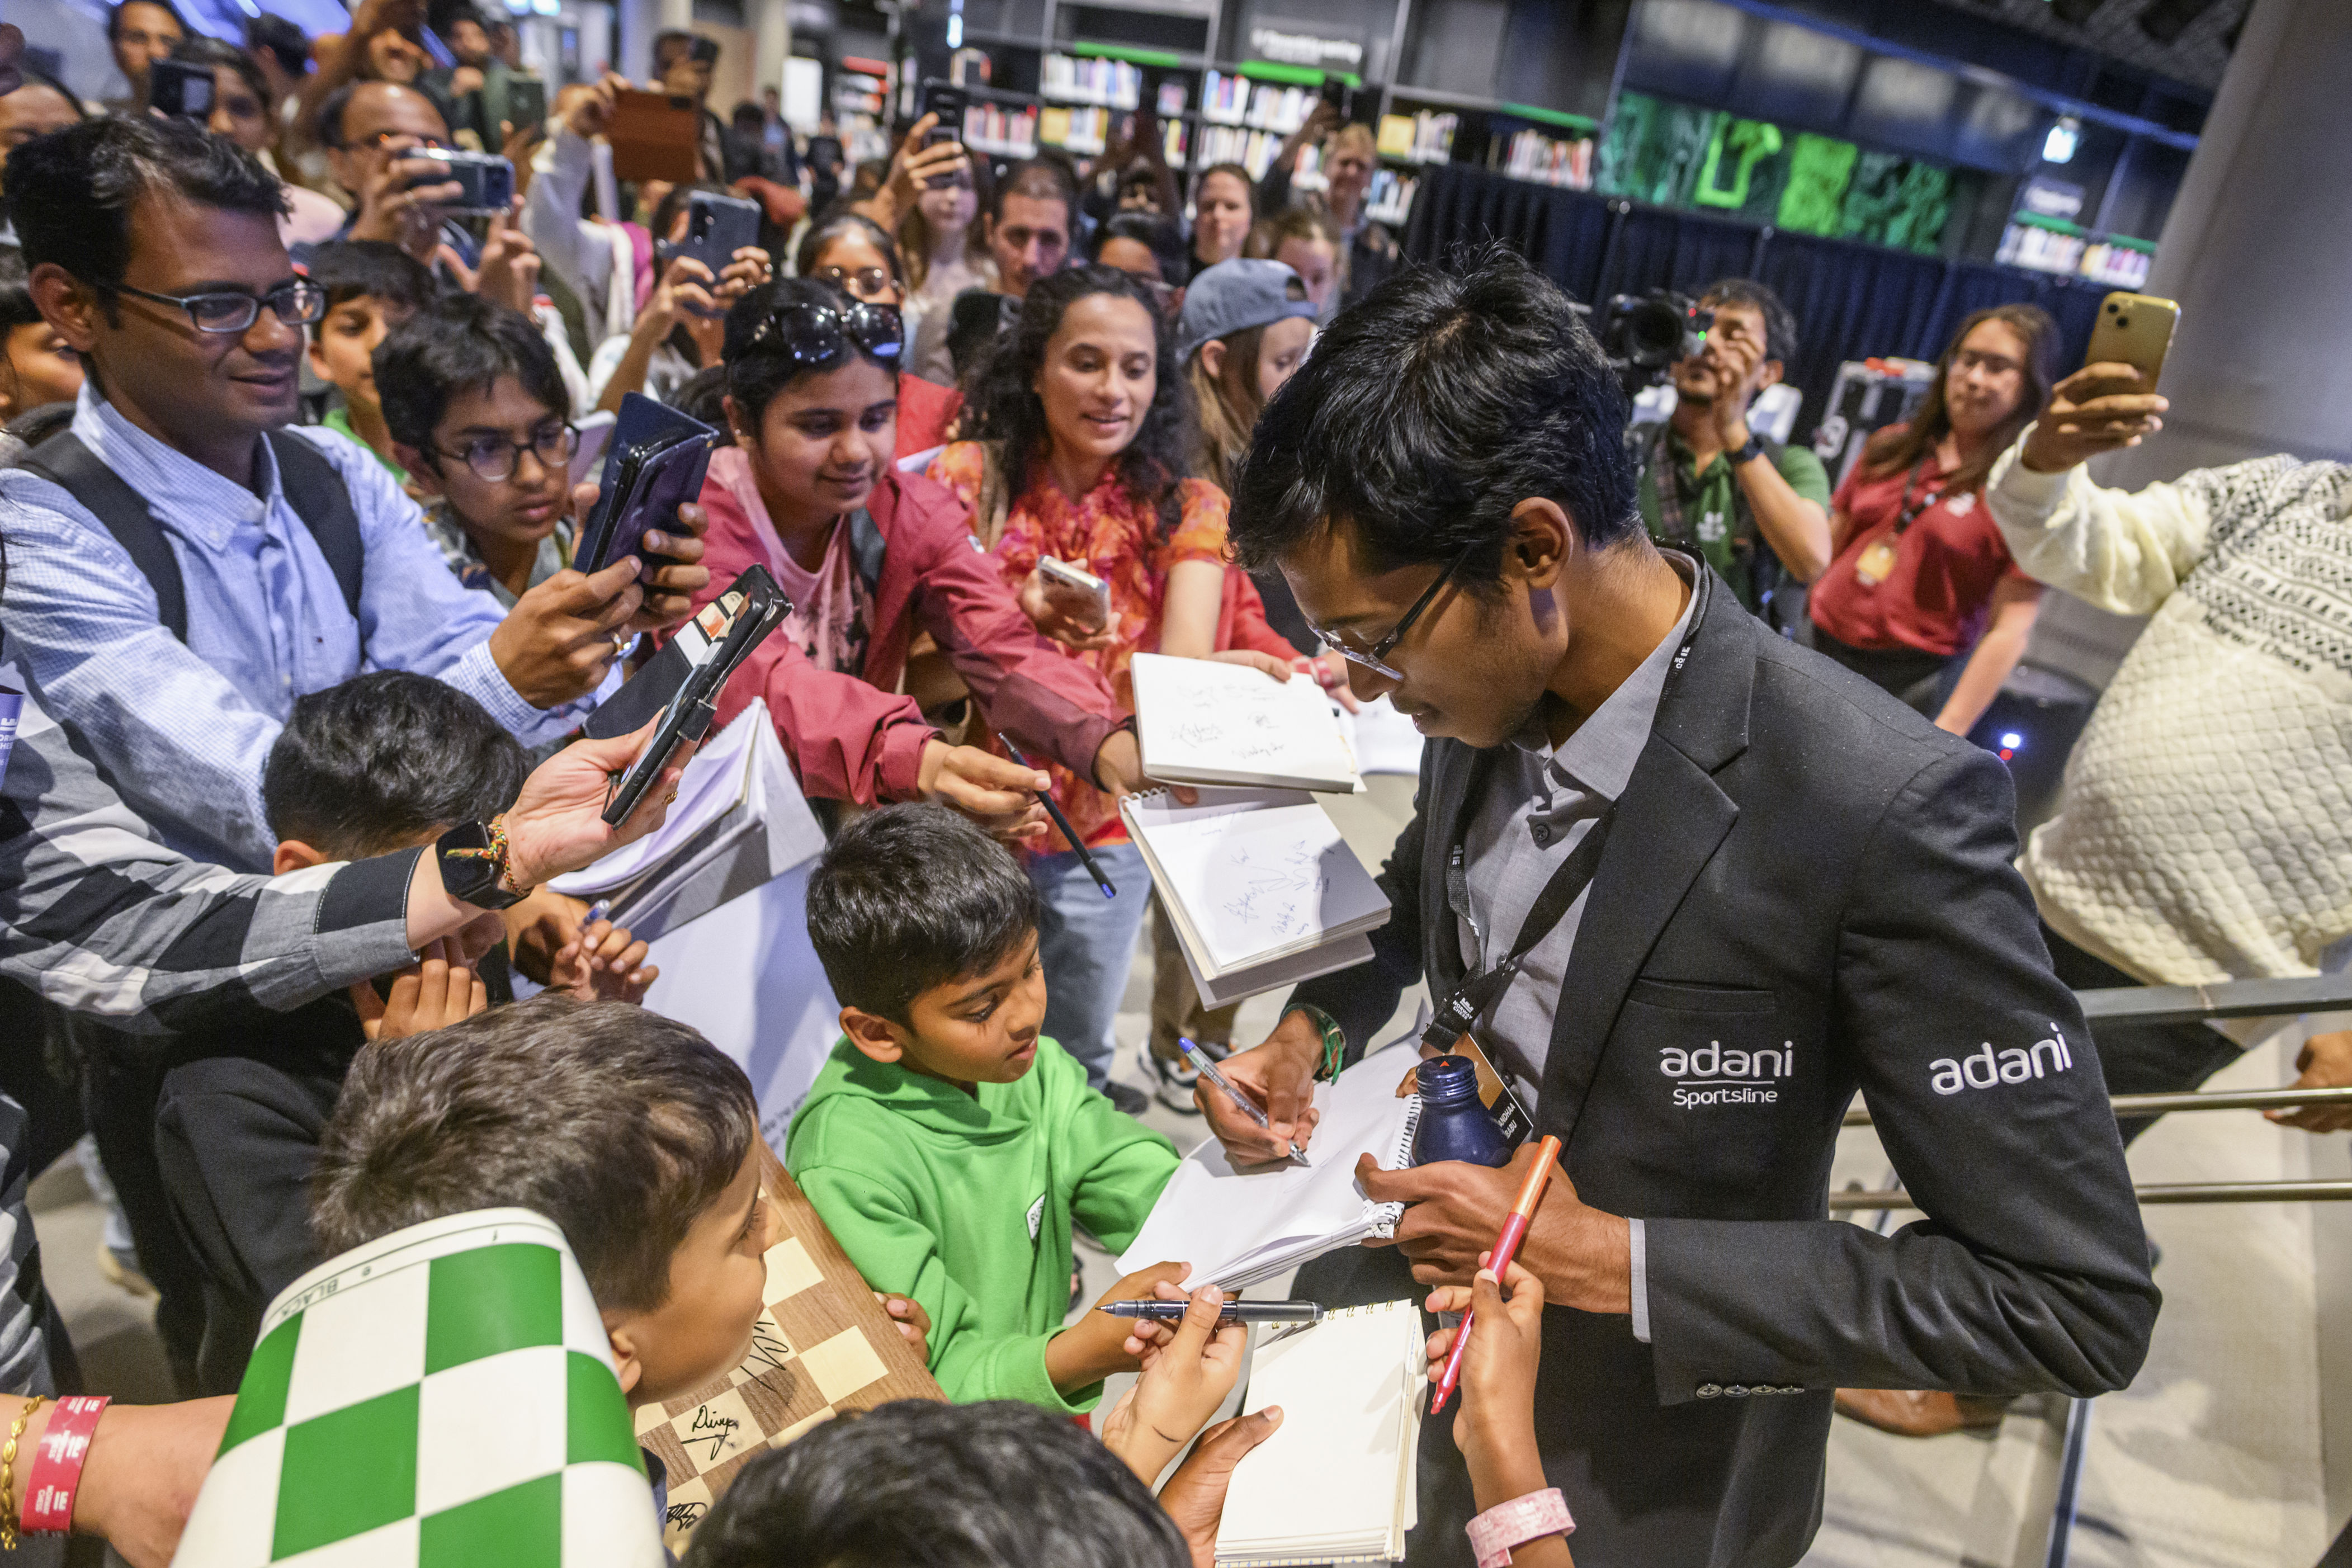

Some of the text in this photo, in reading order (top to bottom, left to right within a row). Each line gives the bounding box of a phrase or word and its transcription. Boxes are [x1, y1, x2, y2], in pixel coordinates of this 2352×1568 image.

[1452, 1000, 1473, 1019] NORWAY
[1659, 1040, 1793, 1078] adani
[1929, 1022, 2072, 1095] adani
[1673, 1088, 1778, 1110] Sportsline
